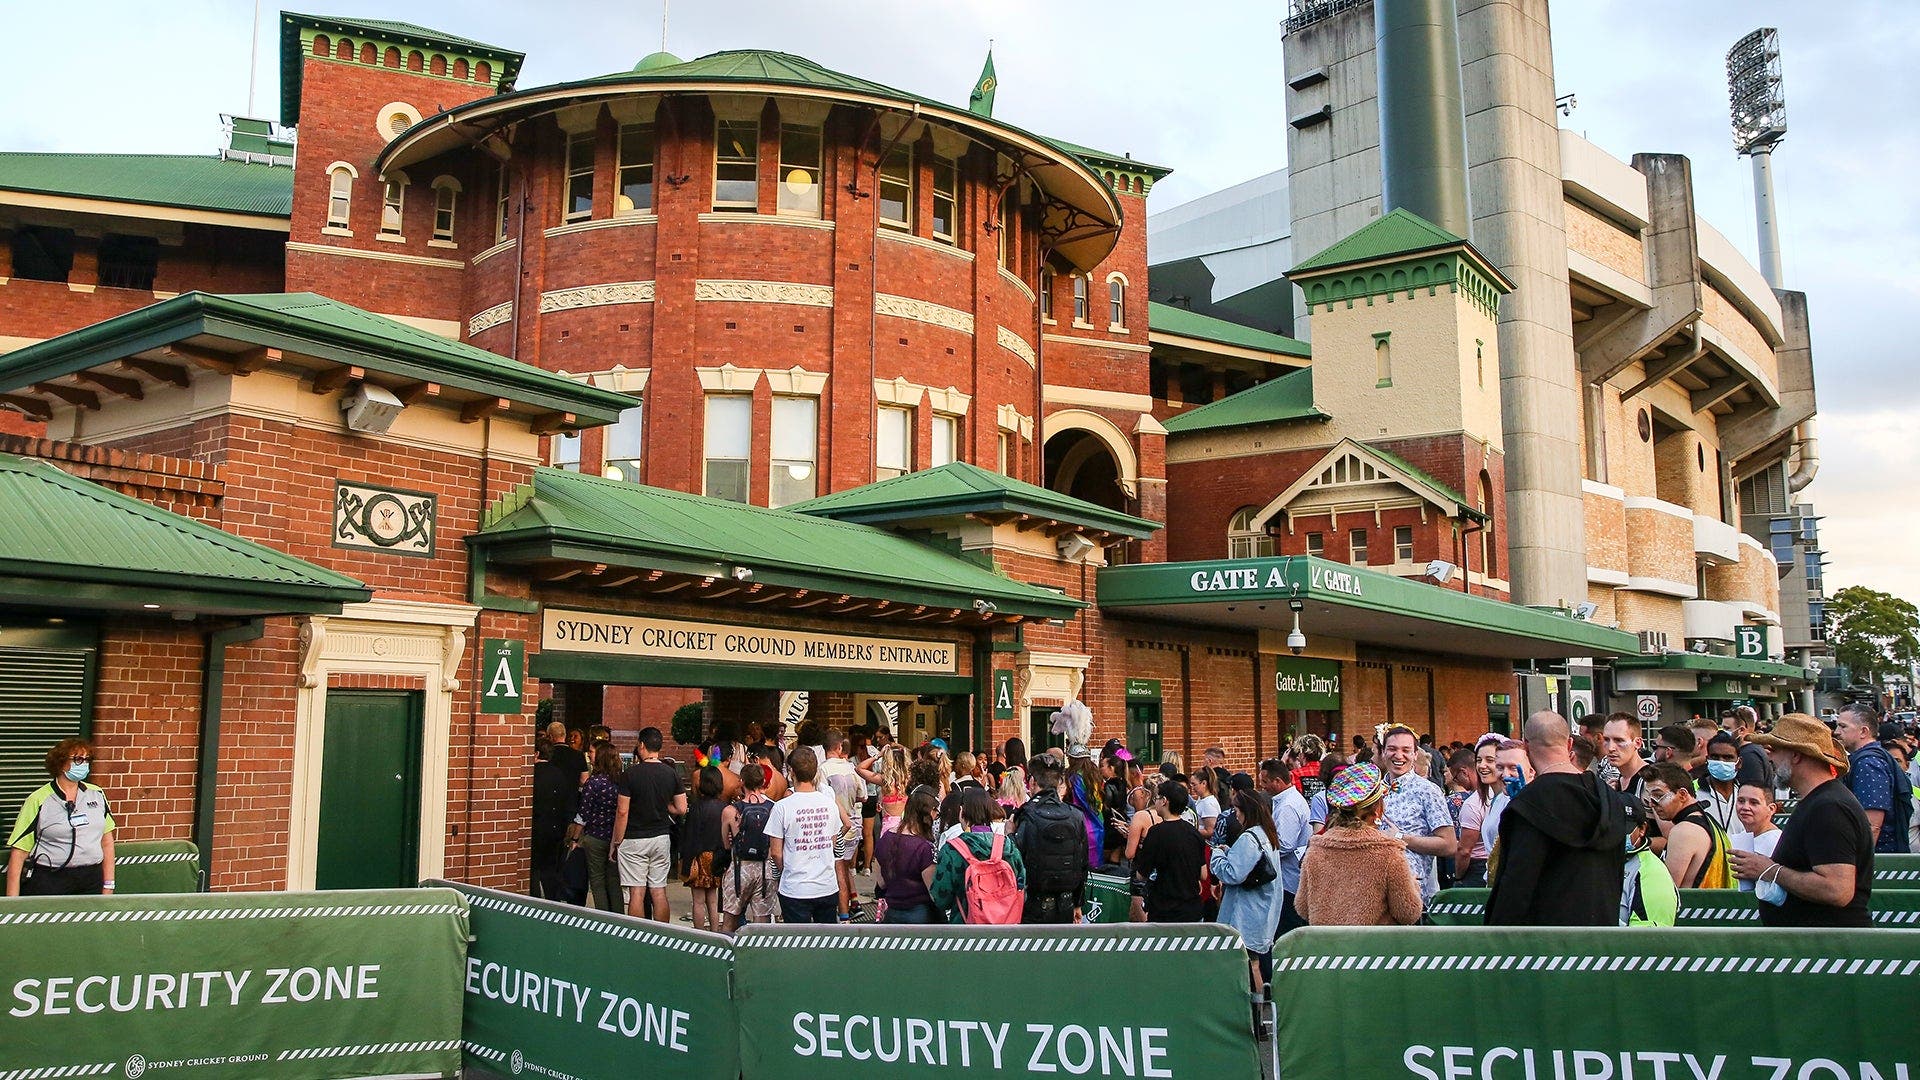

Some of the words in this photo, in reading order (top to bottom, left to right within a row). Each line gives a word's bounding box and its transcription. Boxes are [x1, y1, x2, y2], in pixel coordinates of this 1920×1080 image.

[1190, 569, 1258, 591] GATE
[1265, 567, 1285, 588] A
[1324, 570, 1352, 594] GATE
[1353, 576, 1362, 596] A
[557, 620, 634, 645] SYDNEY
[642, 628, 717, 651] CRICKET
[724, 634, 796, 656] GROUND
[804, 640, 874, 661] MEMBERS'
[879, 646, 949, 665] ENTRANCE
[1739, 631, 1763, 656] B
[486, 657, 519, 697] A
[1276, 672, 1296, 691] Gate
[1298, 673, 1305, 692] A
[1310, 674, 1333, 698] Entry
[1333, 675, 1339, 693] 2
[996, 681, 1012, 709] A
[1641, 703, 1654, 713] 40
[9, 969, 252, 1017] SECURITY
[261, 964, 381, 1004] ZONE
[466, 957, 592, 1023] ECURITY
[598, 991, 690, 1053] ZONE
[793, 1011, 1010, 1069] SECURITY
[1026, 1023, 1173, 1078] ZONE
[148, 1059, 185, 1070] SYDNEY
[187, 1056, 227, 1067] CRICKET
[228, 1053, 269, 1063] GROUND
[524, 1061, 547, 1075] SYDNEY
